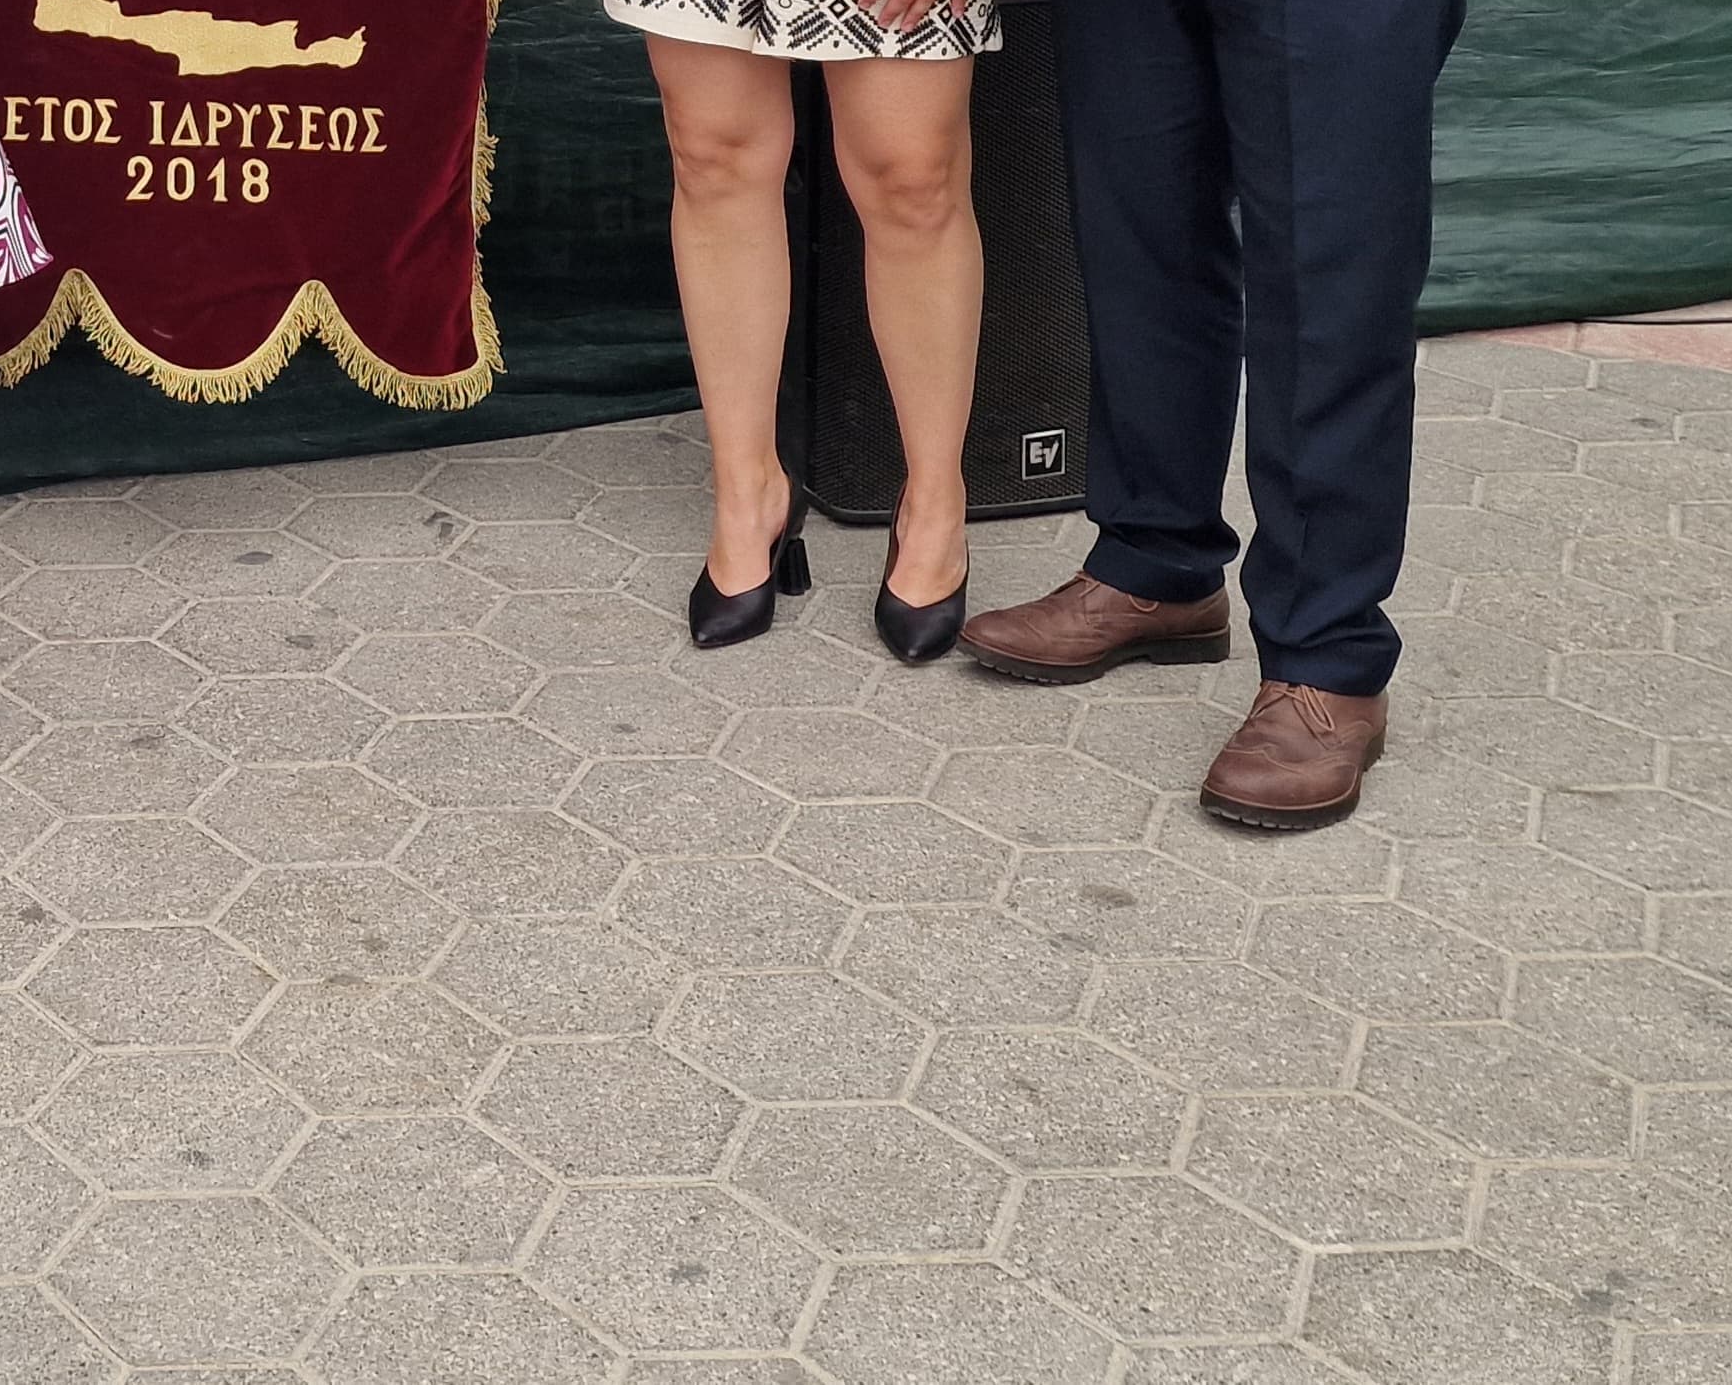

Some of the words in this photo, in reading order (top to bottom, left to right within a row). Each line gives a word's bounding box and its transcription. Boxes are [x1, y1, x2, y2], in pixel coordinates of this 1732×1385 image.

[3, 97, 121, 144] ΕΤΟΣ
[149, 100, 387, 152] ΙΔΡΥΣΕΩΣ
[126, 155, 269, 202] 2018
